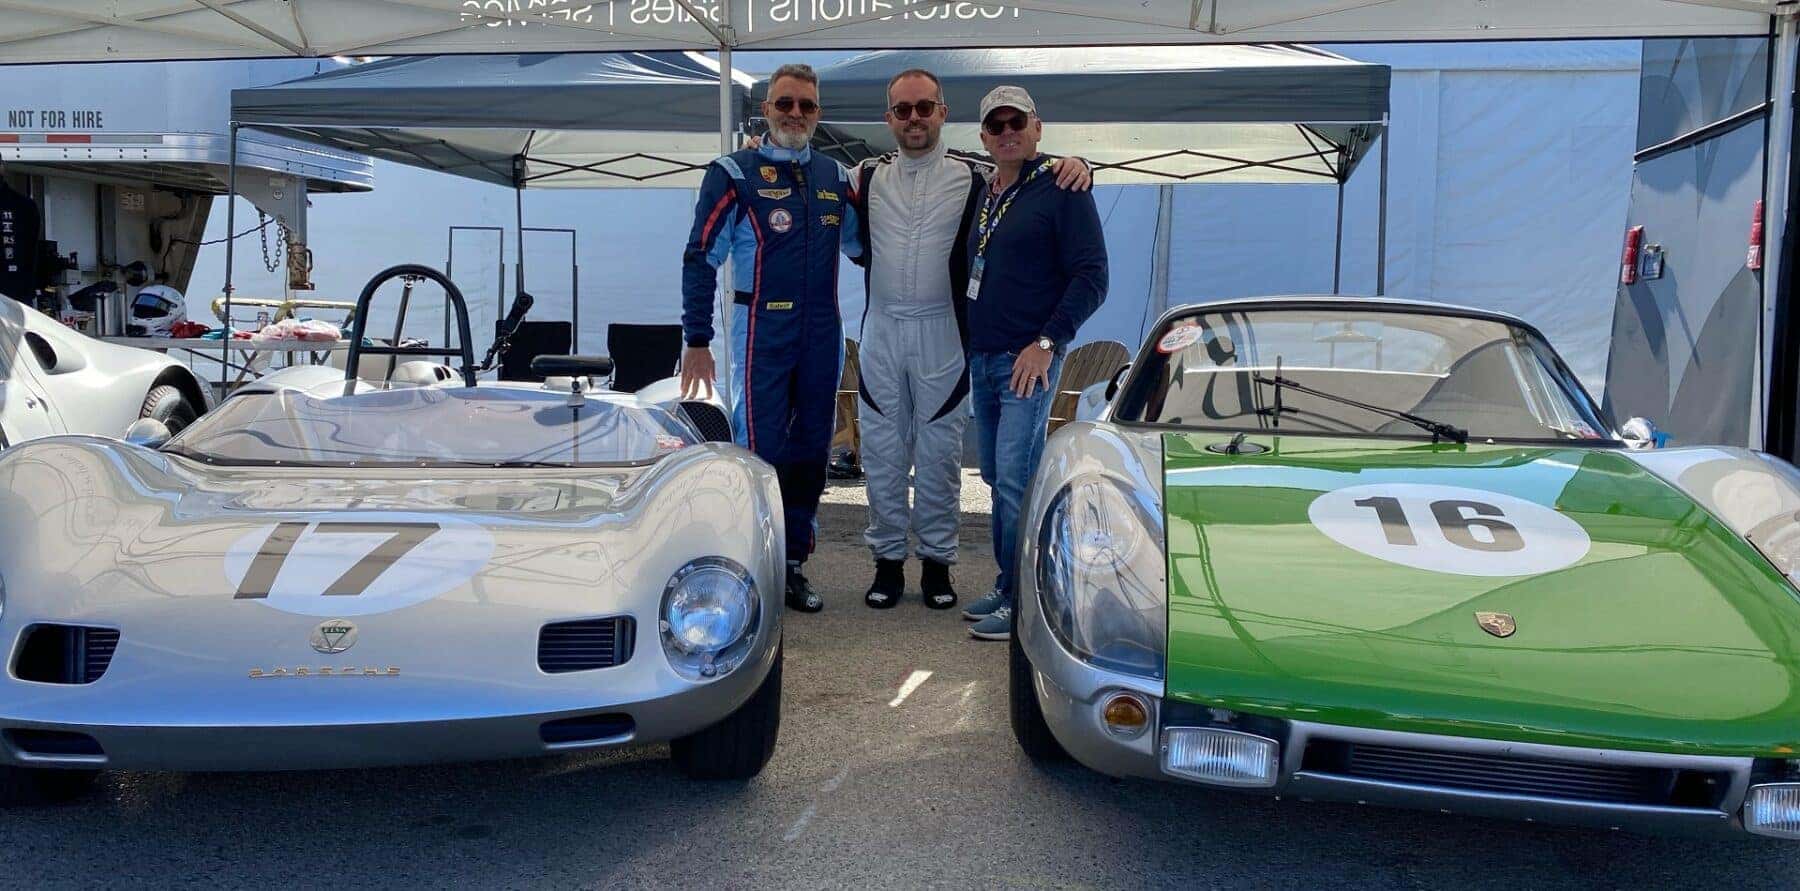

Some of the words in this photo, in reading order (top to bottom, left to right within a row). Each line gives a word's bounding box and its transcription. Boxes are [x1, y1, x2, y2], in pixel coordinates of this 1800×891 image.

[8, 110, 35, 128] NOT
[40, 110, 66, 128] FOR
[72, 110, 104, 128] HIRE
[1354, 496, 1526, 552] 16
[233, 522, 441, 600] 17
[249, 664, 400, 679] PORSCHE
